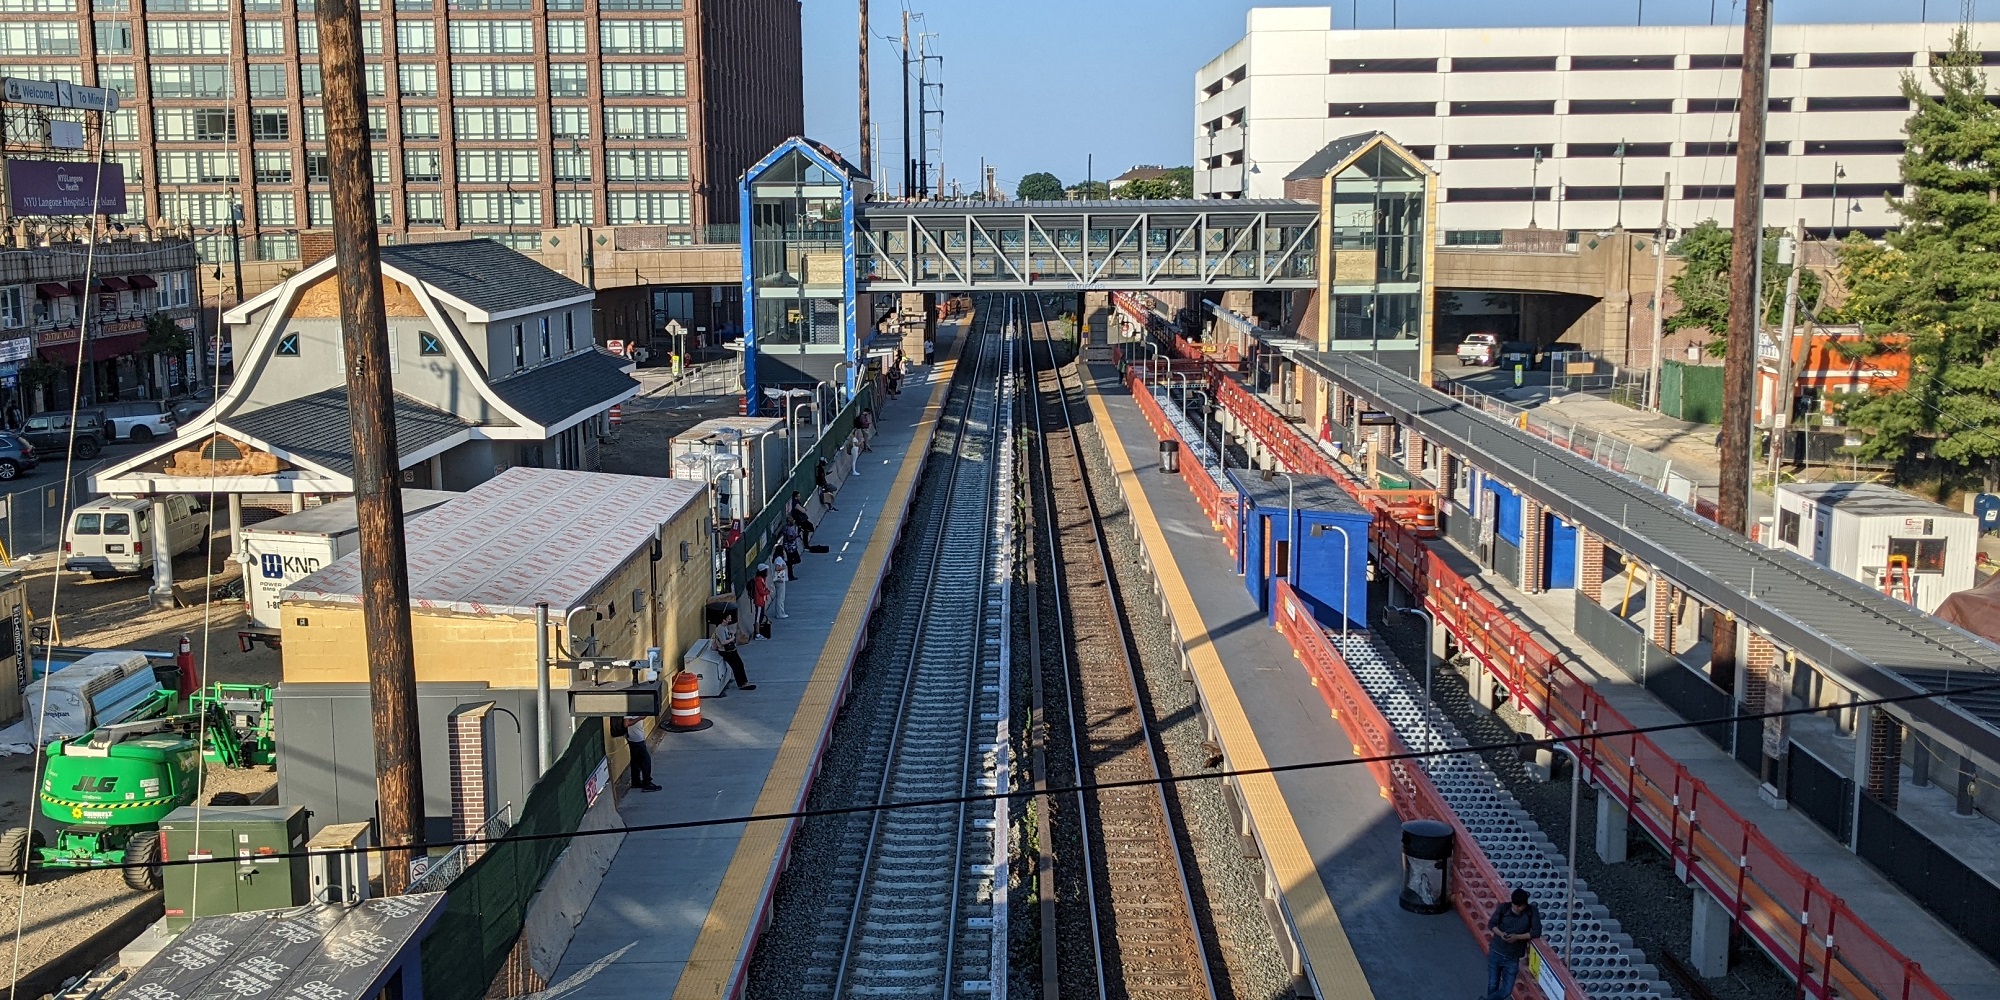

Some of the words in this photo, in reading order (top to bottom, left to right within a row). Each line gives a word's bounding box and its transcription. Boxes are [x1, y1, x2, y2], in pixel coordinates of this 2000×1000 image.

[22, 85, 54, 100] Welcome
[78, 91, 86, 103] To
[67, 175, 83, 183] Langone
[23, 197, 37, 206] NYU
[38, 197, 62, 209] Langone
[101, 197, 116, 206] Island
[72, 776, 119, 792] JLG
[194, 933, 234, 950] GRACE
[270, 926, 311, 943] GRACE
[350, 929, 393, 947] GRACE
[166, 952, 207, 970] GRACE
[248, 956, 290, 974] GRACE
[324, 949, 368, 967] GRACE
[139, 983, 180, 1000] GRACE
[219, 976, 262, 996] GRACE
[304, 981, 349, 1000] GRACE
